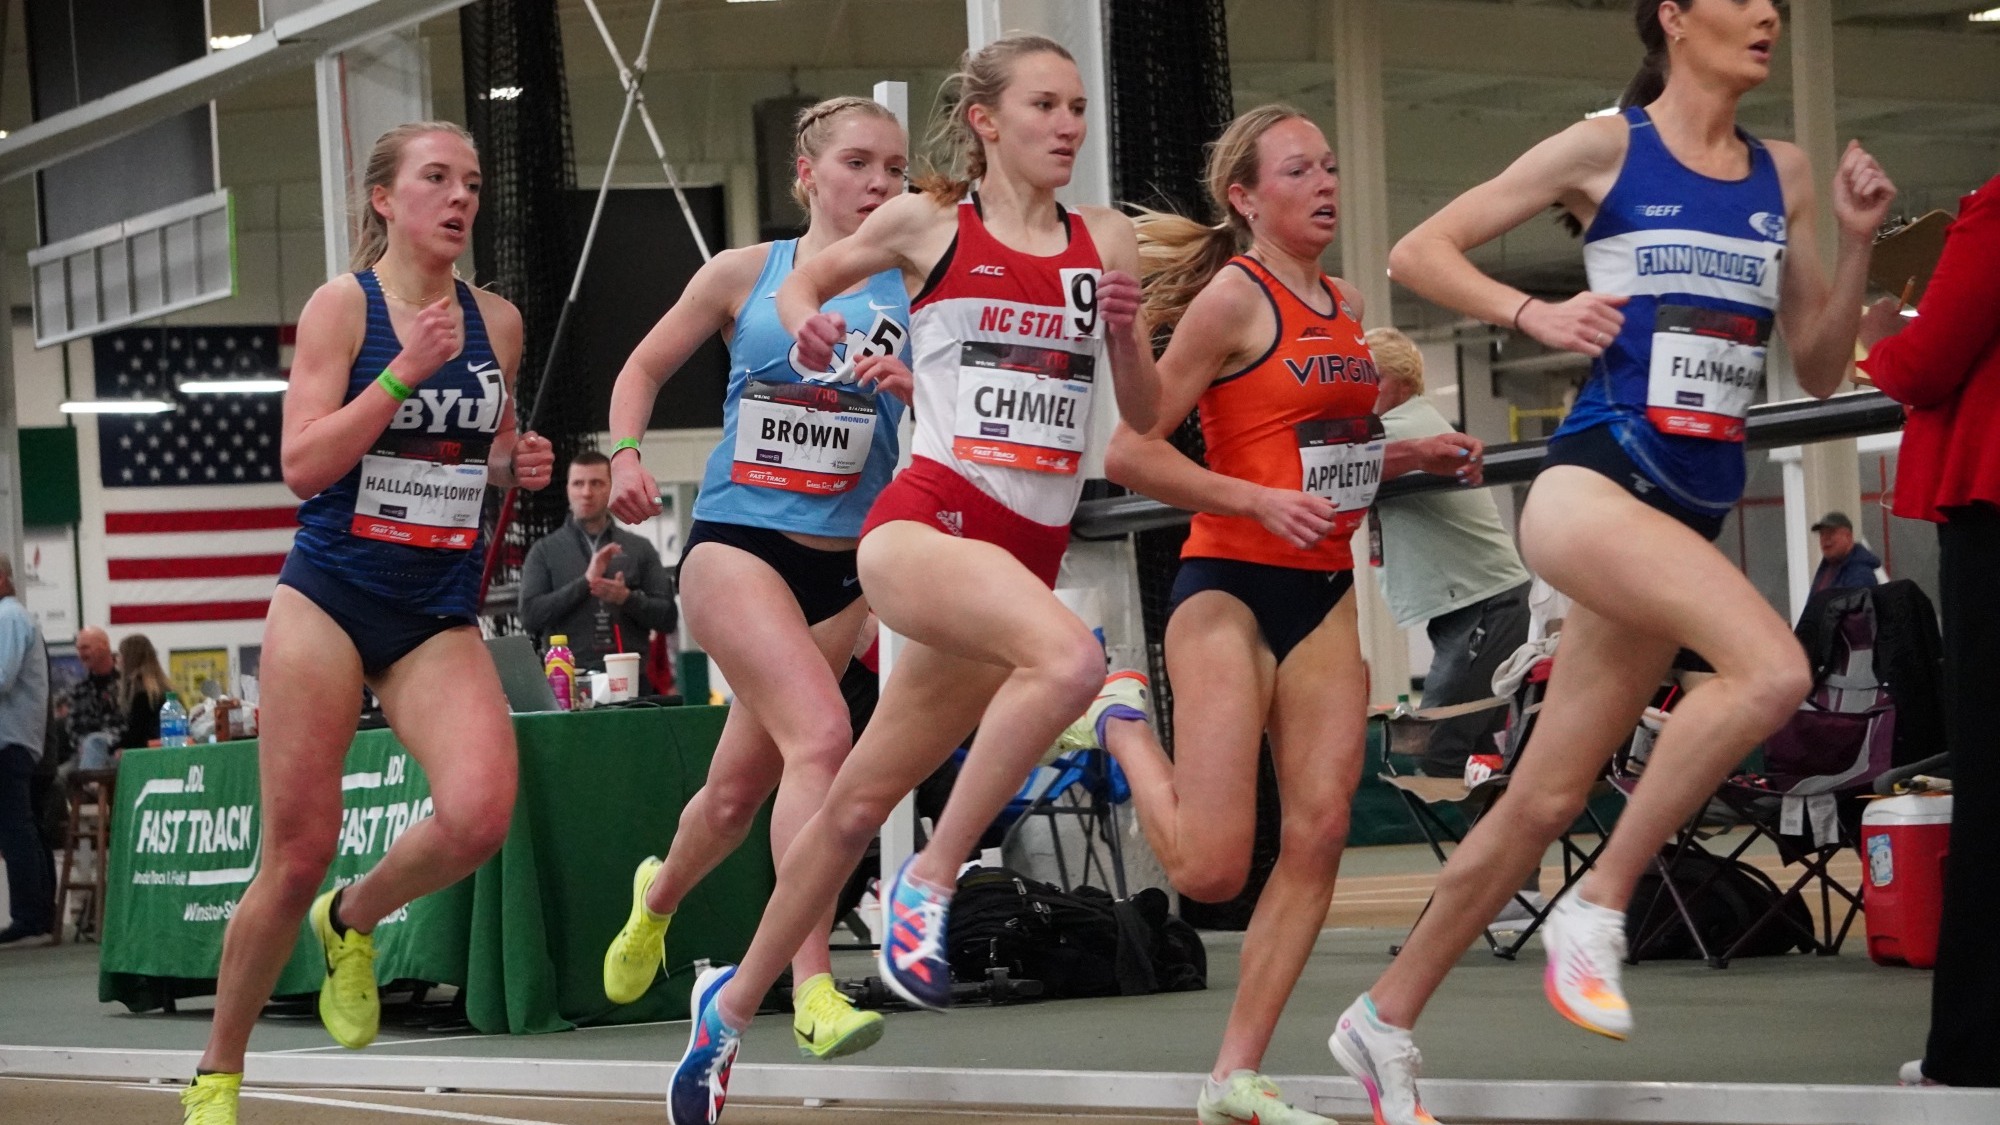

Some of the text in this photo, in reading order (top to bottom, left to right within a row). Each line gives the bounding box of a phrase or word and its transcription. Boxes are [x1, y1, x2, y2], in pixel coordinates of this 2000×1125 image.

[1645, 205, 1682, 216] GEFF
[970, 265, 1005, 276] ACC
[1636, 245, 1765, 286] FINN VALLEY
[1071, 273, 1098, 334] 9
[862, 318, 902, 357] 5
[979, 306, 1083, 342] NC STA
[1301, 327, 1331, 337] ACC
[1671, 356, 1765, 390] FLANAGA
[389, 389, 484, 433] BYU
[840, 415, 870, 424] MONDO
[974, 386, 1076, 429] CHMIEL
[761, 418, 850, 450] BROWN
[365, 476, 482, 501] HALLADAY-LOWRY
[767, 475, 787, 483] TRACK
[1306, 459, 1380, 492] APPLETON
[185, 765, 204, 793] JDL
[384, 754, 406, 787] JDL
[136, 805, 253, 854] FAST TRACK
